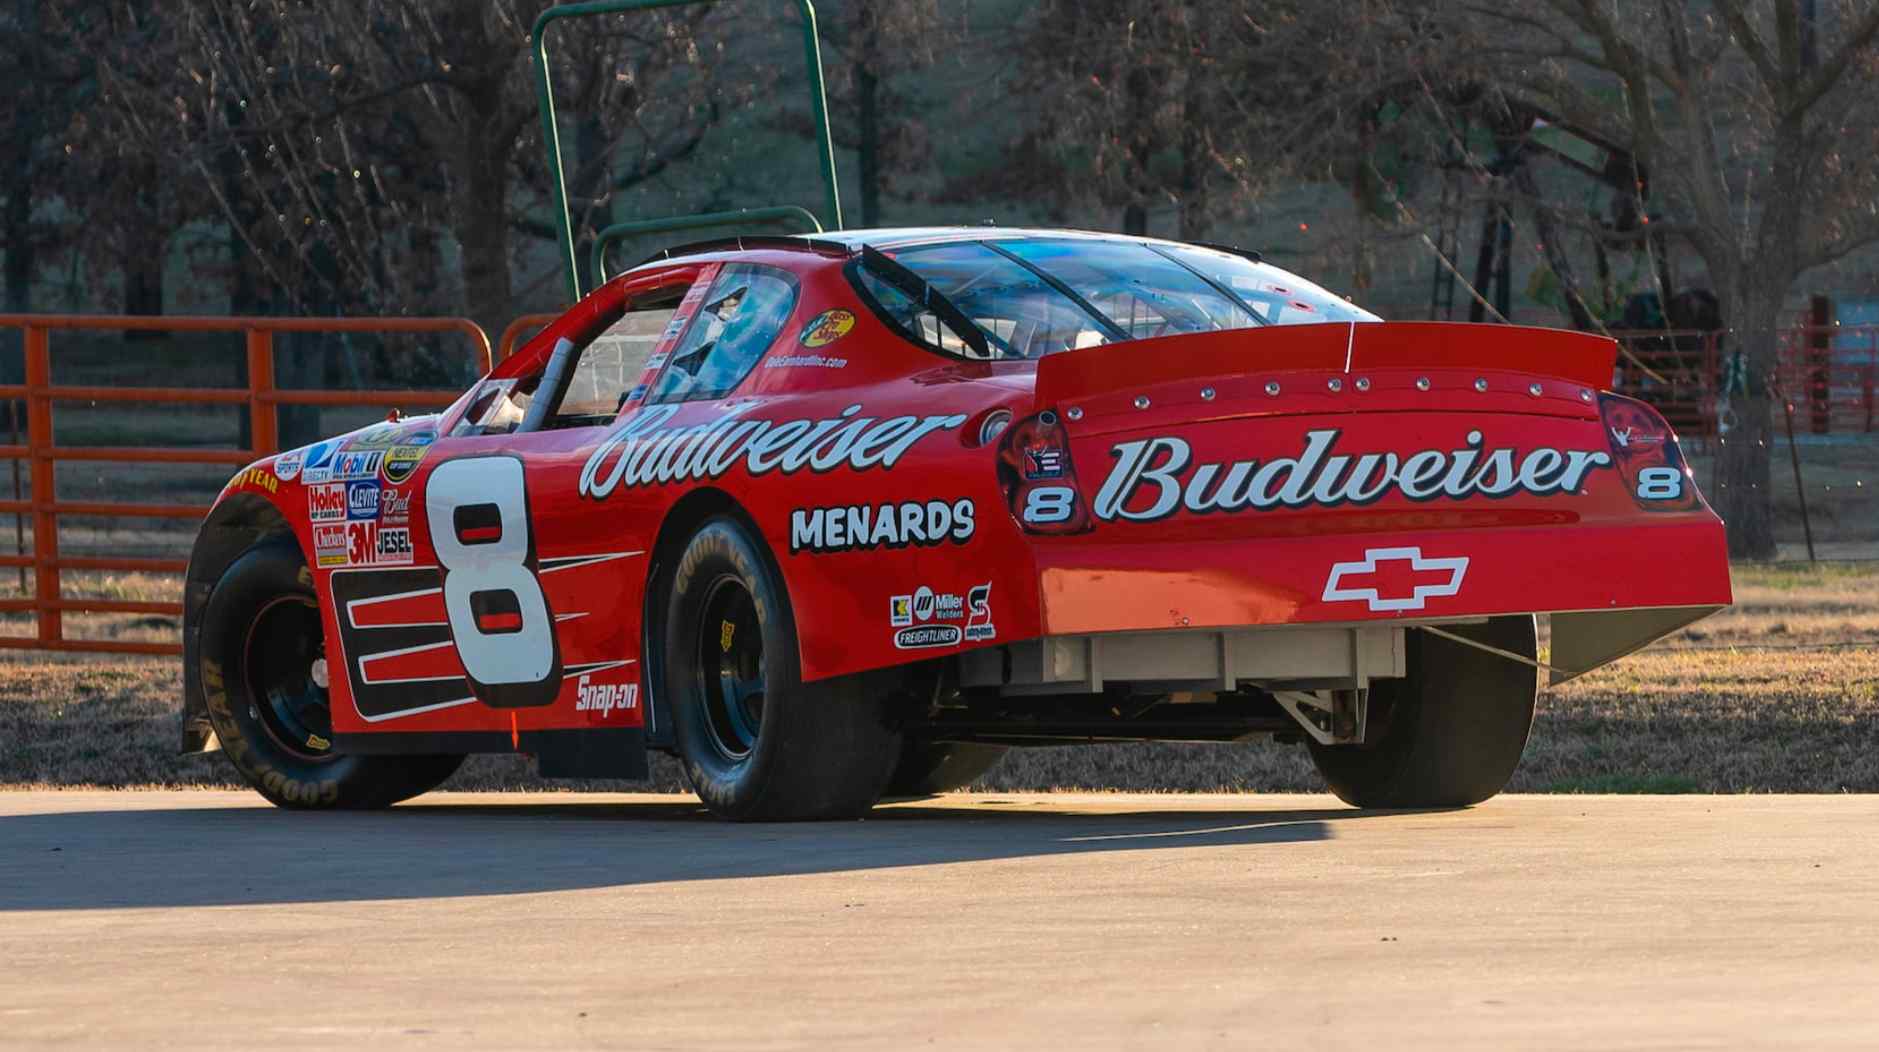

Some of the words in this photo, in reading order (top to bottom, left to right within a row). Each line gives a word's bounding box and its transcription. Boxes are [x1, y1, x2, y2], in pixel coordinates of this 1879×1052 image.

[333, 451, 367, 474] Mobil
[579, 403, 968, 499] Budweiser
[1094, 429, 1611, 522] Budweiser
[1637, 467, 1681, 499] 8
[311, 485, 345, 518] Holley
[1023, 486, 1075, 523] 8
[377, 531, 412, 554] JESEL
[791, 498, 975, 550] MENARDS
[348, 522, 377, 564] 3M
[421, 454, 554, 685] 8
[935, 593, 964, 609] Miller
[899, 628, 957, 644] FREIGHTLINER
[575, 675, 639, 718] Snap-on
